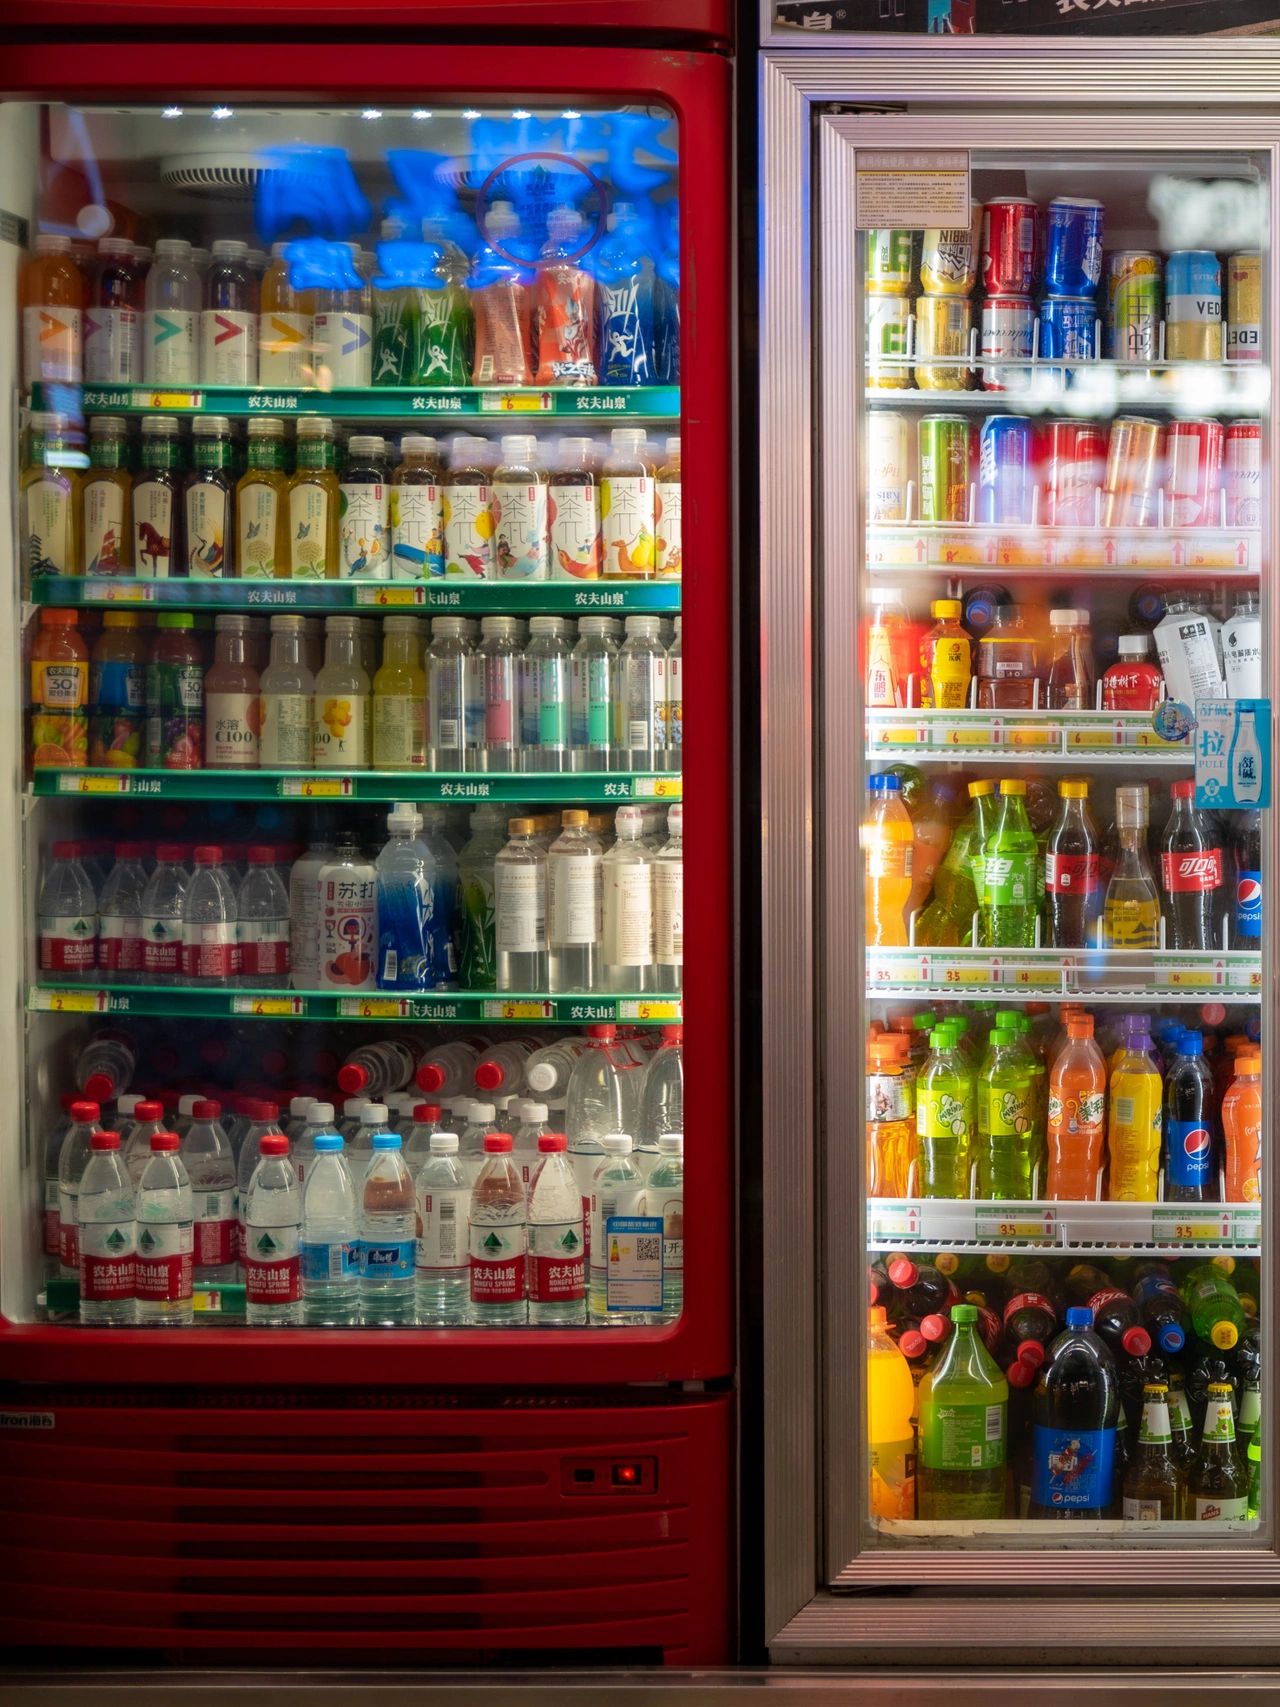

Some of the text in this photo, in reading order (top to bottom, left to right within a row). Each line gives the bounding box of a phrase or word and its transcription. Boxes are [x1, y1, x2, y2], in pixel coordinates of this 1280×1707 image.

[1196, 301, 1221, 315] VED
[248, 395, 298, 409] 农夫山泉
[412, 396, 462, 409] 农夫山泉
[576, 396, 626, 409] 农夫山泉
[247, 591, 297, 603] 农夫山泉
[428, 592, 461, 604] 夫山泉
[575, 592, 625, 605] 农夫山泉
[216, 720, 239, 730] 水溶
[1199, 730, 1226, 757] 拉
[1199, 760, 1226, 769] PULL
[133, 781, 161, 792] 山泉
[440, 783, 490, 795] 农夫山泉
[604, 783, 631, 795] 农夫
[1179, 856, 1217, 878] 可口可
[338, 881, 374, 898] 苏打
[1238, 912, 1261, 921] pepsi
[1080, 1097, 1105, 1122] 美年
[1187, 1162, 1209, 1172] pepsi
[1001, 1224, 1016, 1235] 3.5
[1176, 1225, 1192, 1238] 3.5
[136, 1265, 169, 1278] 夫山泉
[474, 1267, 516, 1280] 农夫山泉
[1064, 1493, 1090, 1504] pepsi
